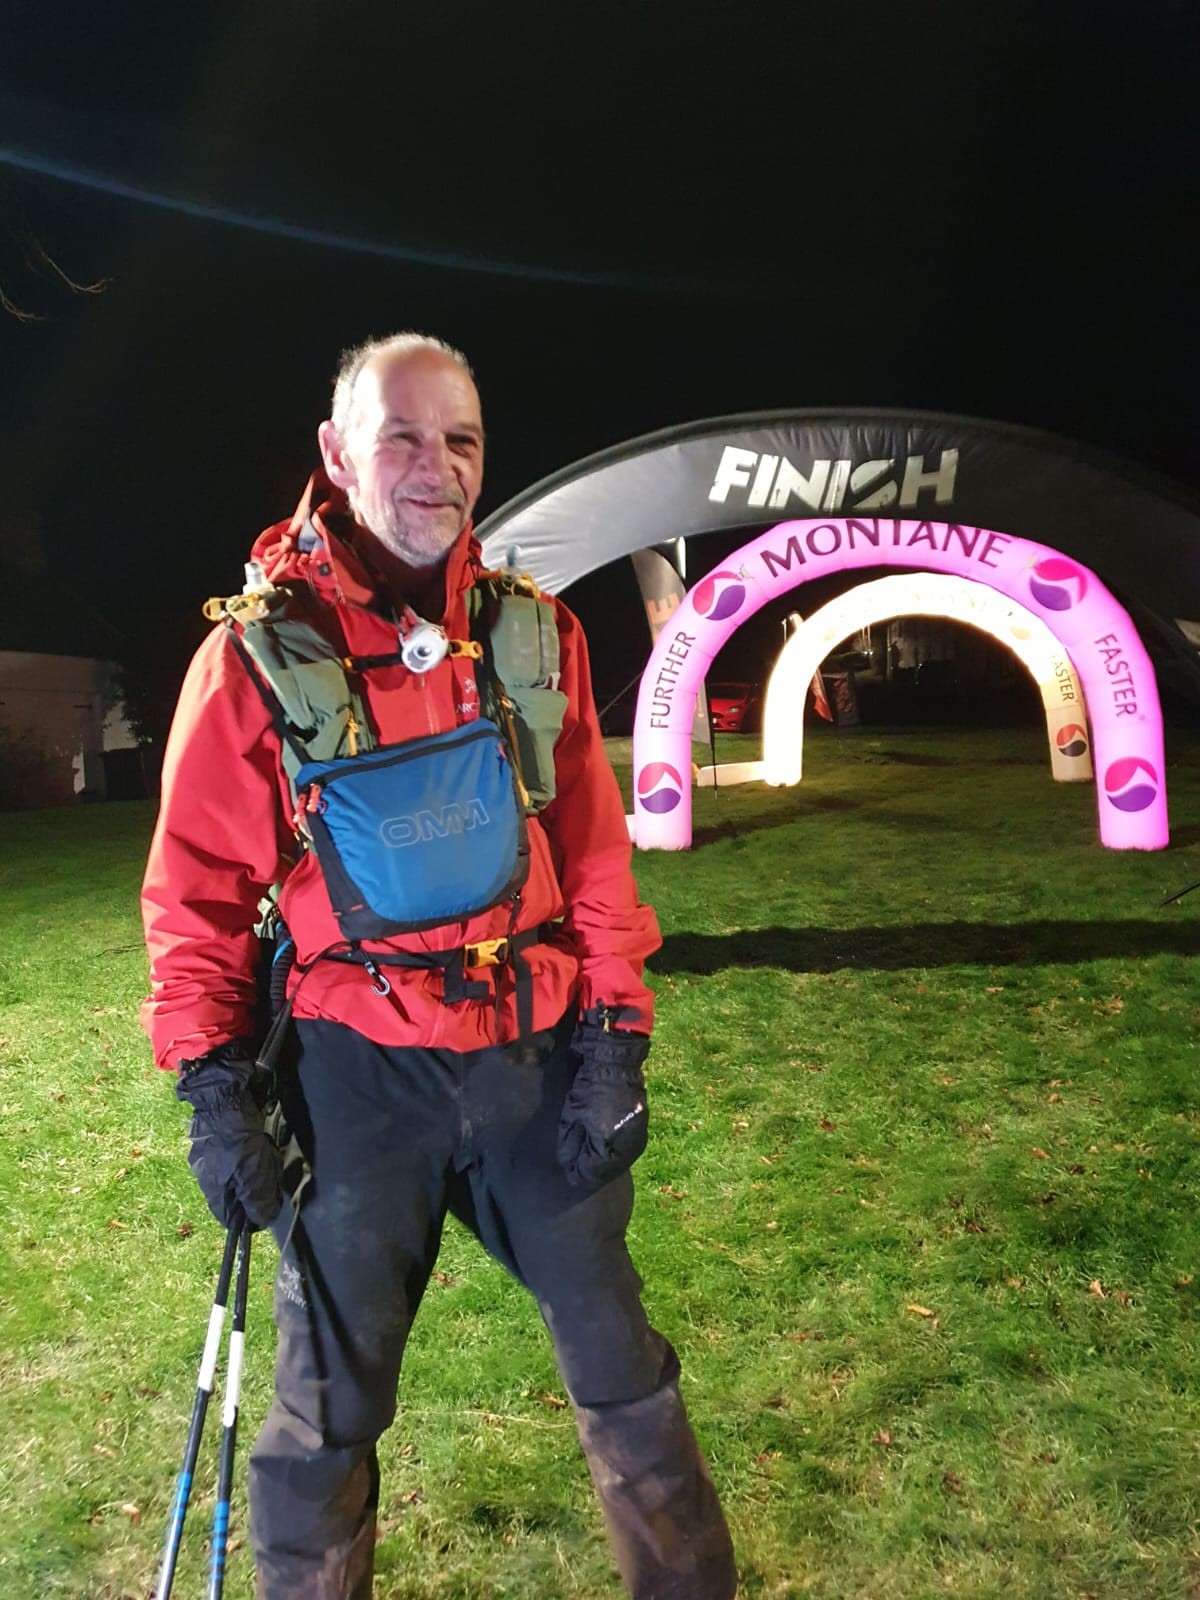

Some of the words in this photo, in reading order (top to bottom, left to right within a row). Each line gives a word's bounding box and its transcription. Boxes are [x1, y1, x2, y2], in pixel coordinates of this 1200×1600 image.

[708, 445, 959, 515] FINISH
[759, 518, 1012, 578] MONTANE
[650, 631, 696, 729] FURTHER
[1050, 655, 1076, 702] ASTER
[1094, 632, 1138, 717] FASTER
[380, 798, 491, 848] OMM
